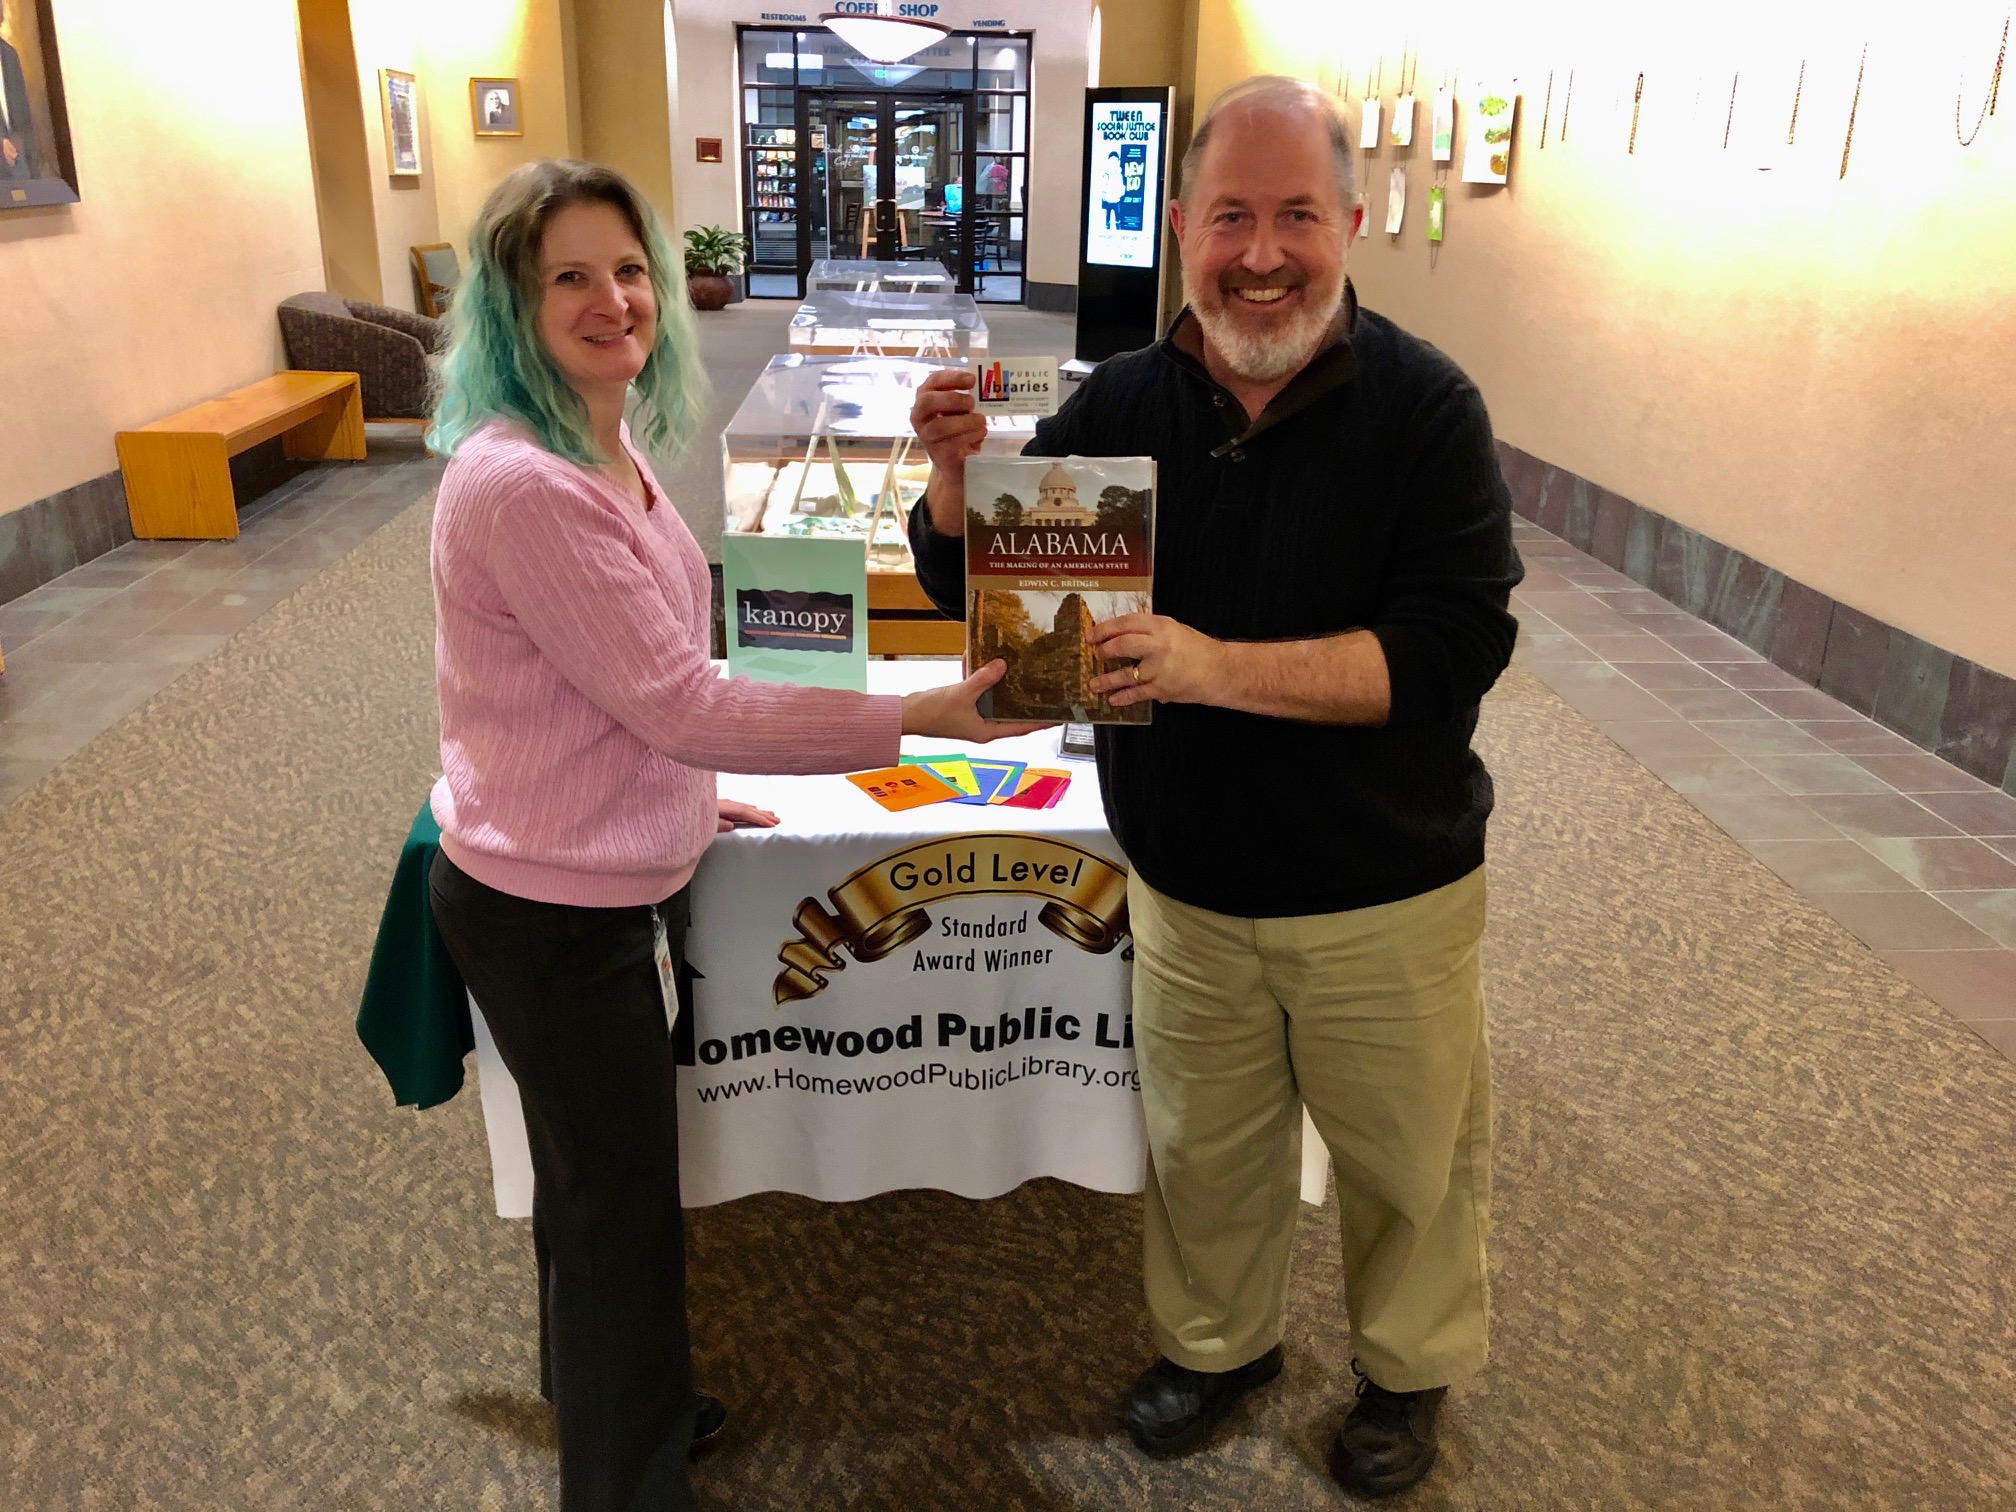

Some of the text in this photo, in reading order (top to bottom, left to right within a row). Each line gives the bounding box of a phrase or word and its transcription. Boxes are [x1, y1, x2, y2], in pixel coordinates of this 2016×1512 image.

[761, 13, 807, 21] RESTROOMS
[835, 1, 938, 17] COFF SHOP
[1109, 110, 1143, 121] TWEEN
[1097, 122, 1156, 131] SOCIAL JUSTICE
[1103, 131, 1149, 141] BOOK CLUB
[987, 532, 1130, 556] ALABAMA
[1051, 562, 1062, 570] AN
[1019, 580, 1100, 588] EDWIN C. BRIDGES
[744, 600, 847, 634] kanopy
[889, 851, 1084, 891] Gold Level
[941, 910, 1028, 940] Standard
[912, 946, 1053, 973] Award Winner
[937, 1006, 1081, 1053] Public
[697, 1055, 1141, 1103] www.HomewoodPublicLibrary.org
